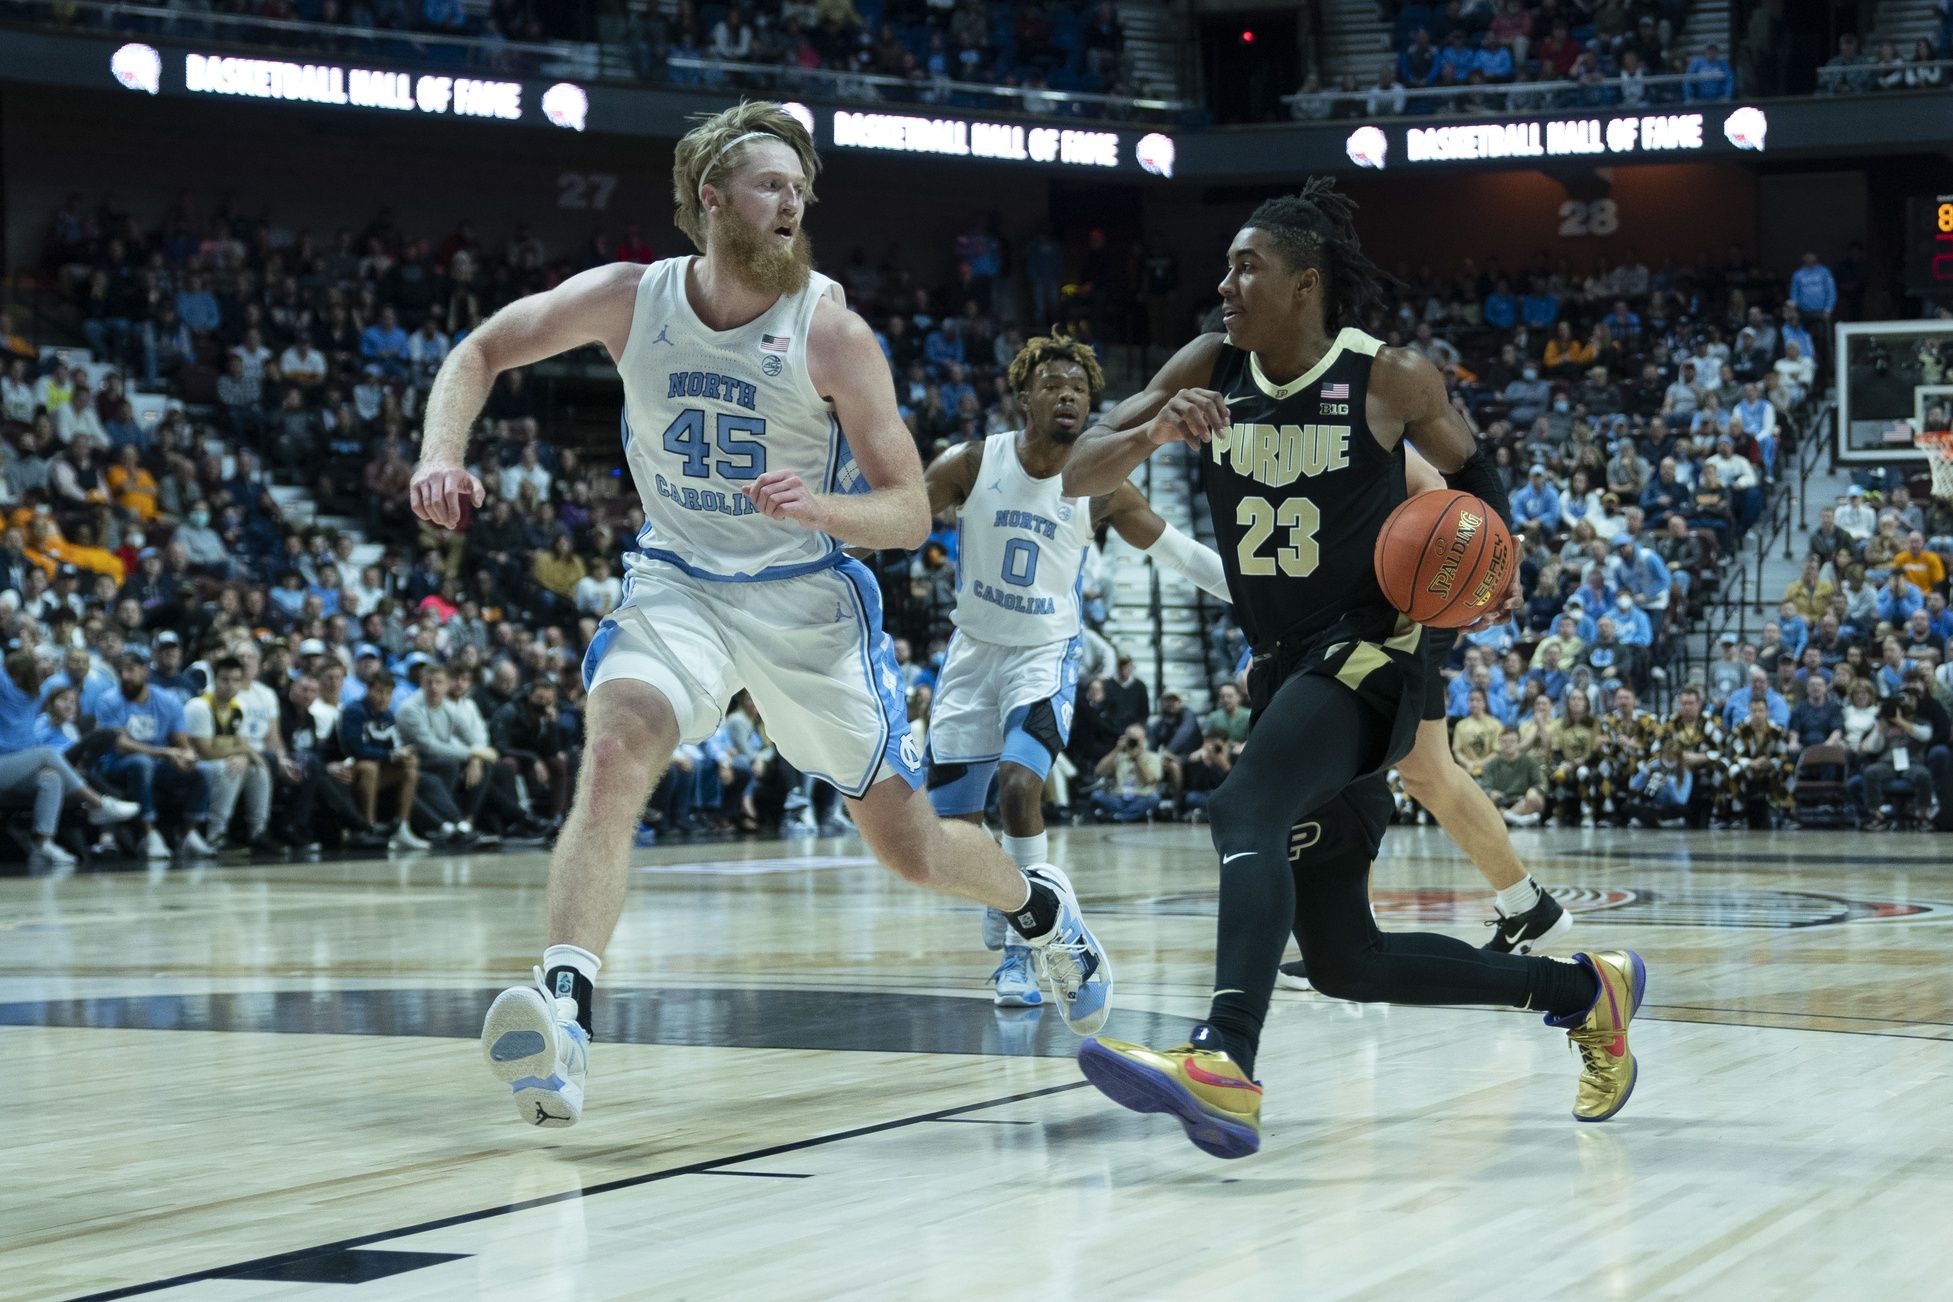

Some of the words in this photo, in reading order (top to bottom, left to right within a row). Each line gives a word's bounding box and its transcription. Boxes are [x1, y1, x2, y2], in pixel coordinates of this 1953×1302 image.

[186, 53, 348, 104] BASKETBALL
[350, 69, 415, 110] HALL
[417, 75, 452, 113] OF
[453, 78, 522, 119] FAME
[834, 111, 970, 155] BASKETBALL
[971, 122, 1027, 159] HALL
[1028, 127, 1060, 162] OF
[1060, 129, 1119, 167] FAME
[1407, 122, 1544, 161] BASKETBALL
[1546, 119, 1605, 155] HALL
[1606, 117, 1639, 152] OF
[1640, 114, 1703, 150] FAME
[558, 172, 617, 208] 27
[1558, 199, 1618, 236] 28
[668, 372, 757, 411] NORTH
[663, 408, 766, 480] 45
[1211, 423, 1351, 488] PURDUE
[655, 474, 760, 516] CAROLI
[993, 510, 1057, 540] NORTH
[1236, 496, 1320, 577] 23
[1001, 537, 1040, 587] 0
[1427, 510, 1482, 599] SPALDING
[1464, 533, 1504, 608] LEGACY
[973, 579, 1056, 615] CAROLINA
